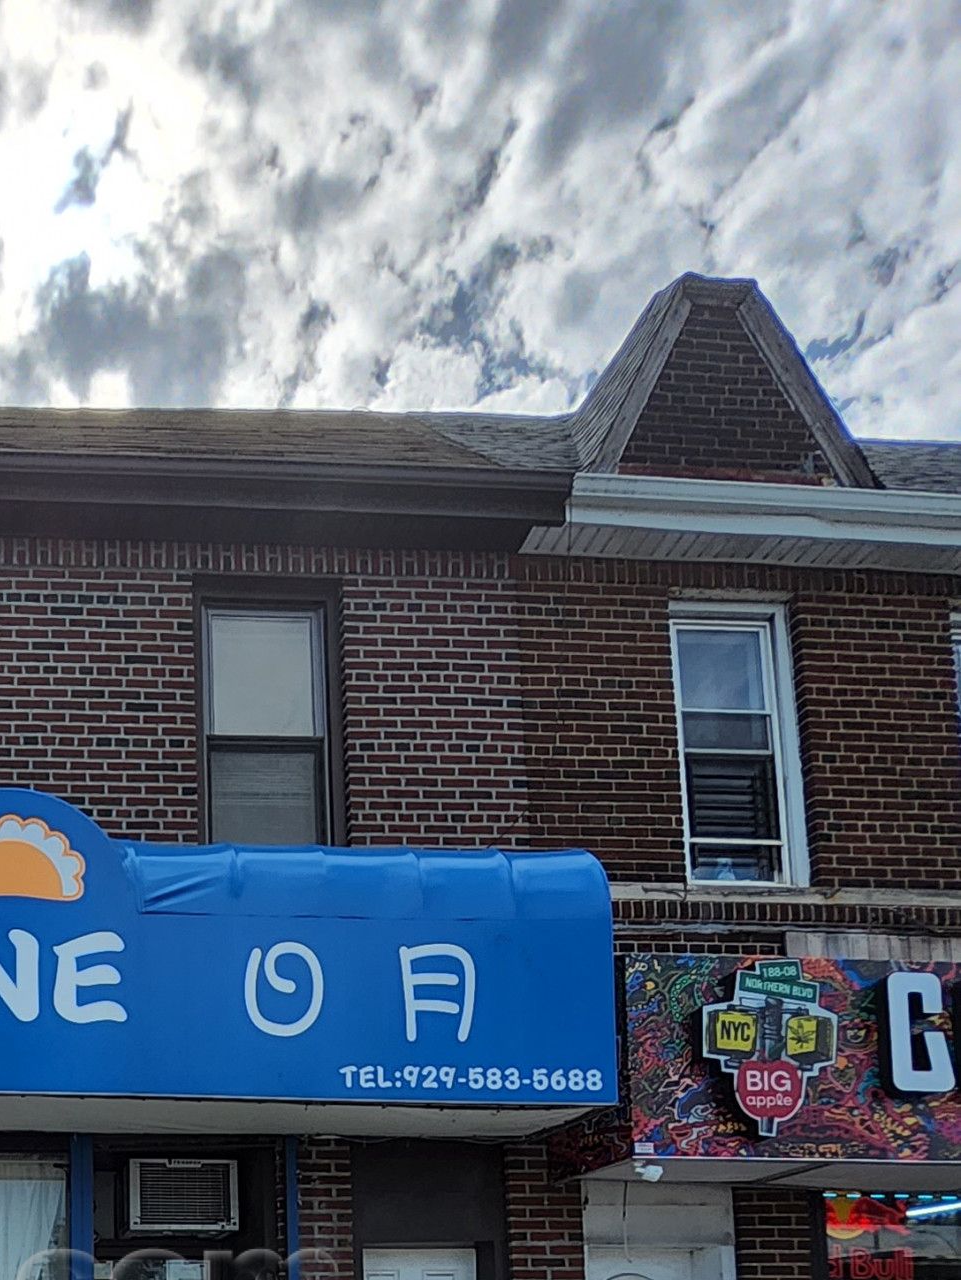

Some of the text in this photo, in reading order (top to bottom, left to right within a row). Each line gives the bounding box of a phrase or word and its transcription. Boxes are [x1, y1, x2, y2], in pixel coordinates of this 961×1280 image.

[762, 965, 798, 978] 188-08
[745, 977, 814, 999] NORTHERN BLVD
[720, 1019, 751, 1042] NYC
[339, 1065, 604, 1091] TEL:929-583-5688
[746, 1070, 792, 1092] BIG
[746, 1093, 793, 1109] apple
[850, 1246, 914, 1280] Bull
